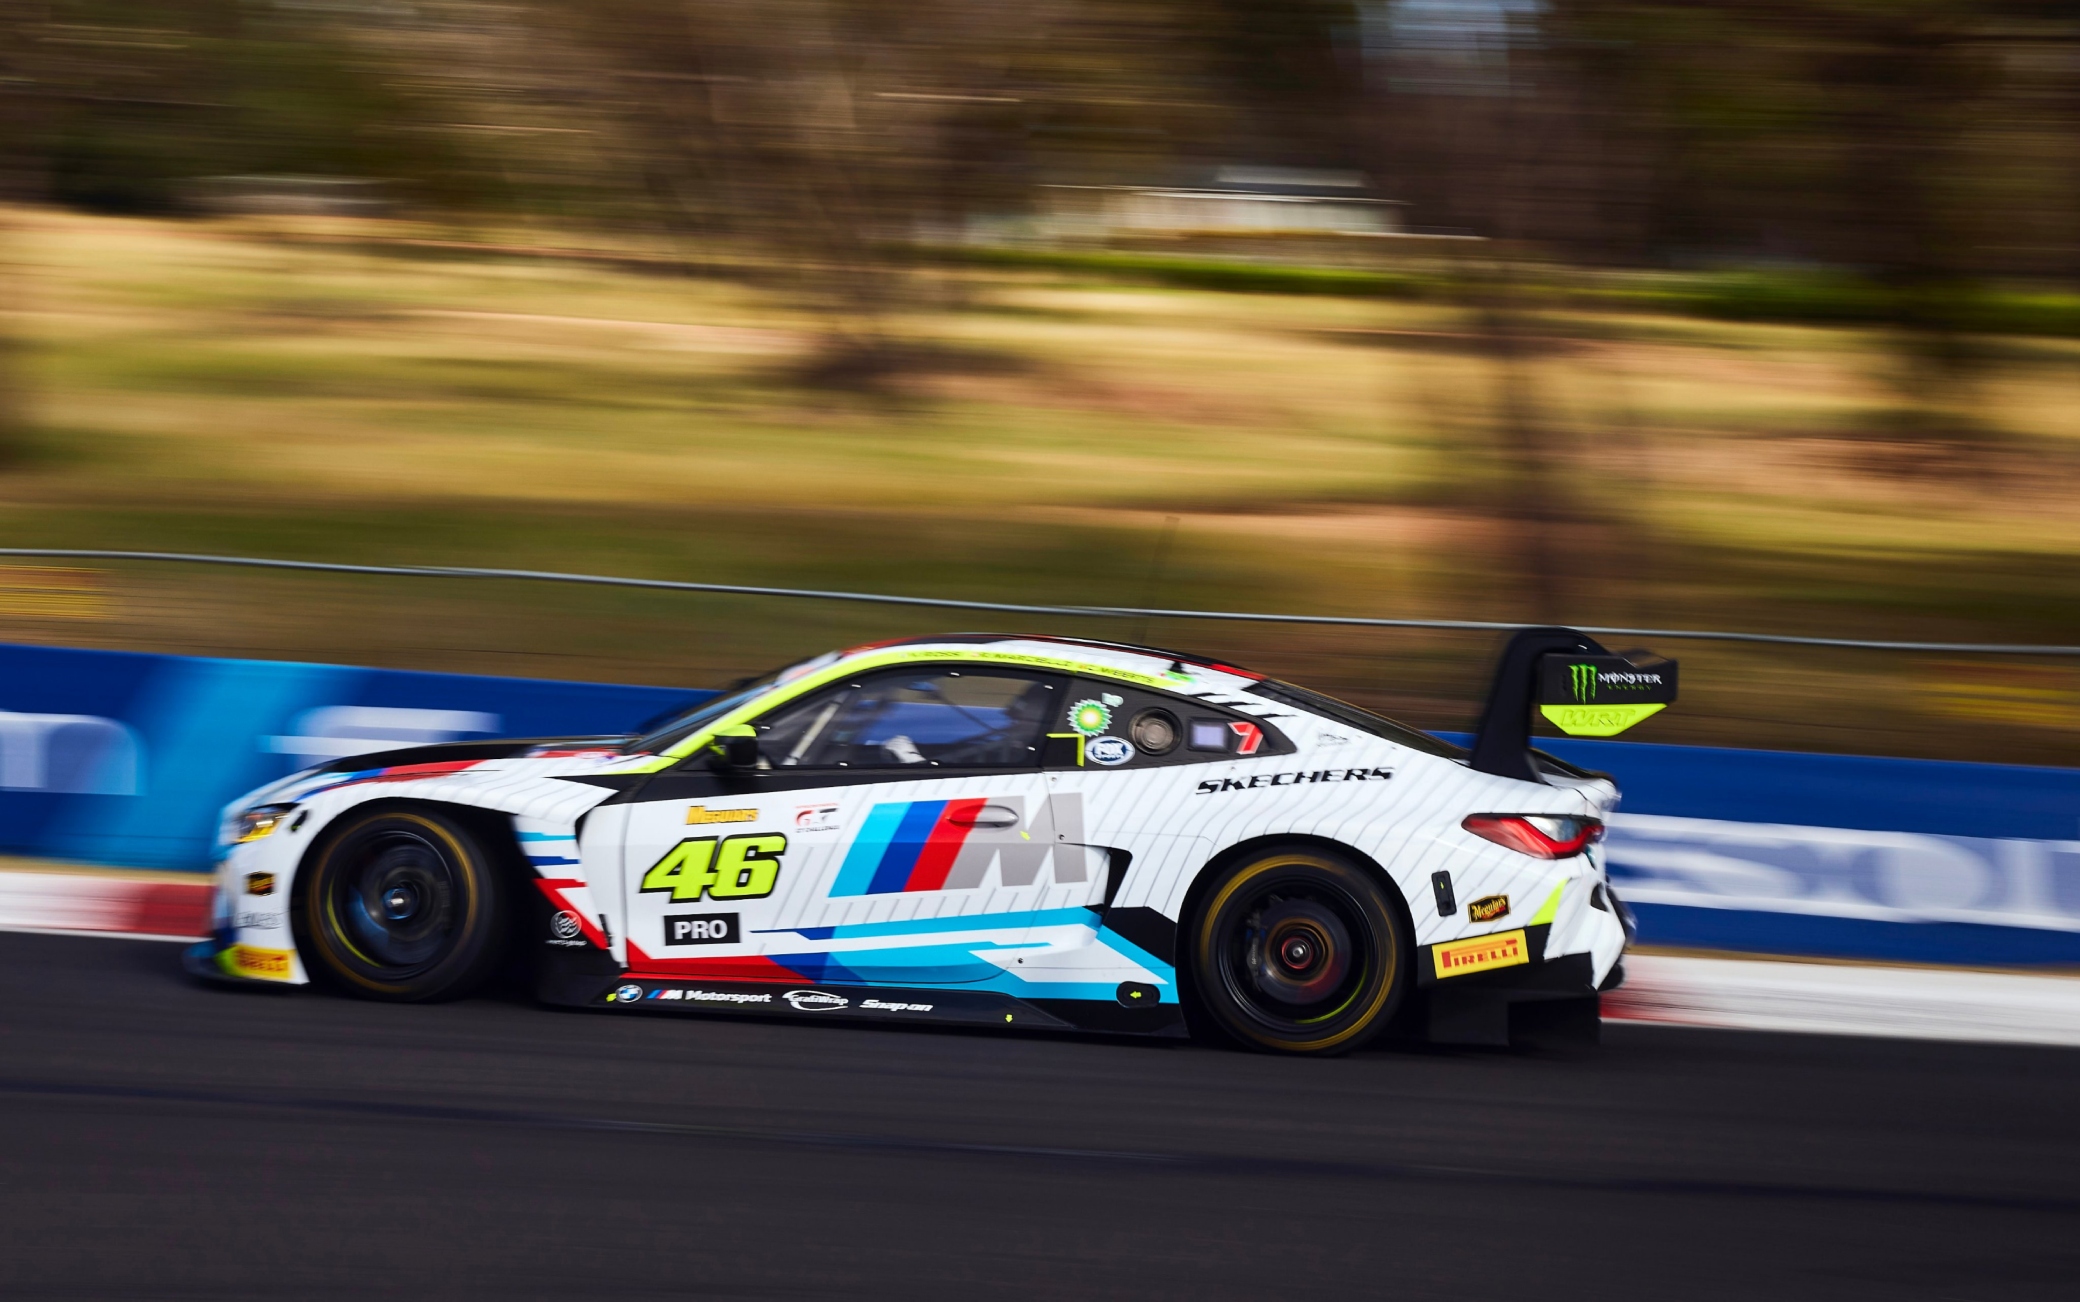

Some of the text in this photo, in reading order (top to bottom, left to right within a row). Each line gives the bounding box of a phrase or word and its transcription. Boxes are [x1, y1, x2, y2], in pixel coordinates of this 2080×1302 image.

[1597, 671, 1662, 685] MONSTER
[1561, 709, 1635, 727] WRT
[1196, 767, 1395, 795] SKECHERS
[639, 832, 788, 903] 46
[674, 919, 728, 941] PRO
[1441, 938, 1518, 969] PIRELLI
[685, 990, 772, 1004] Motorsport
